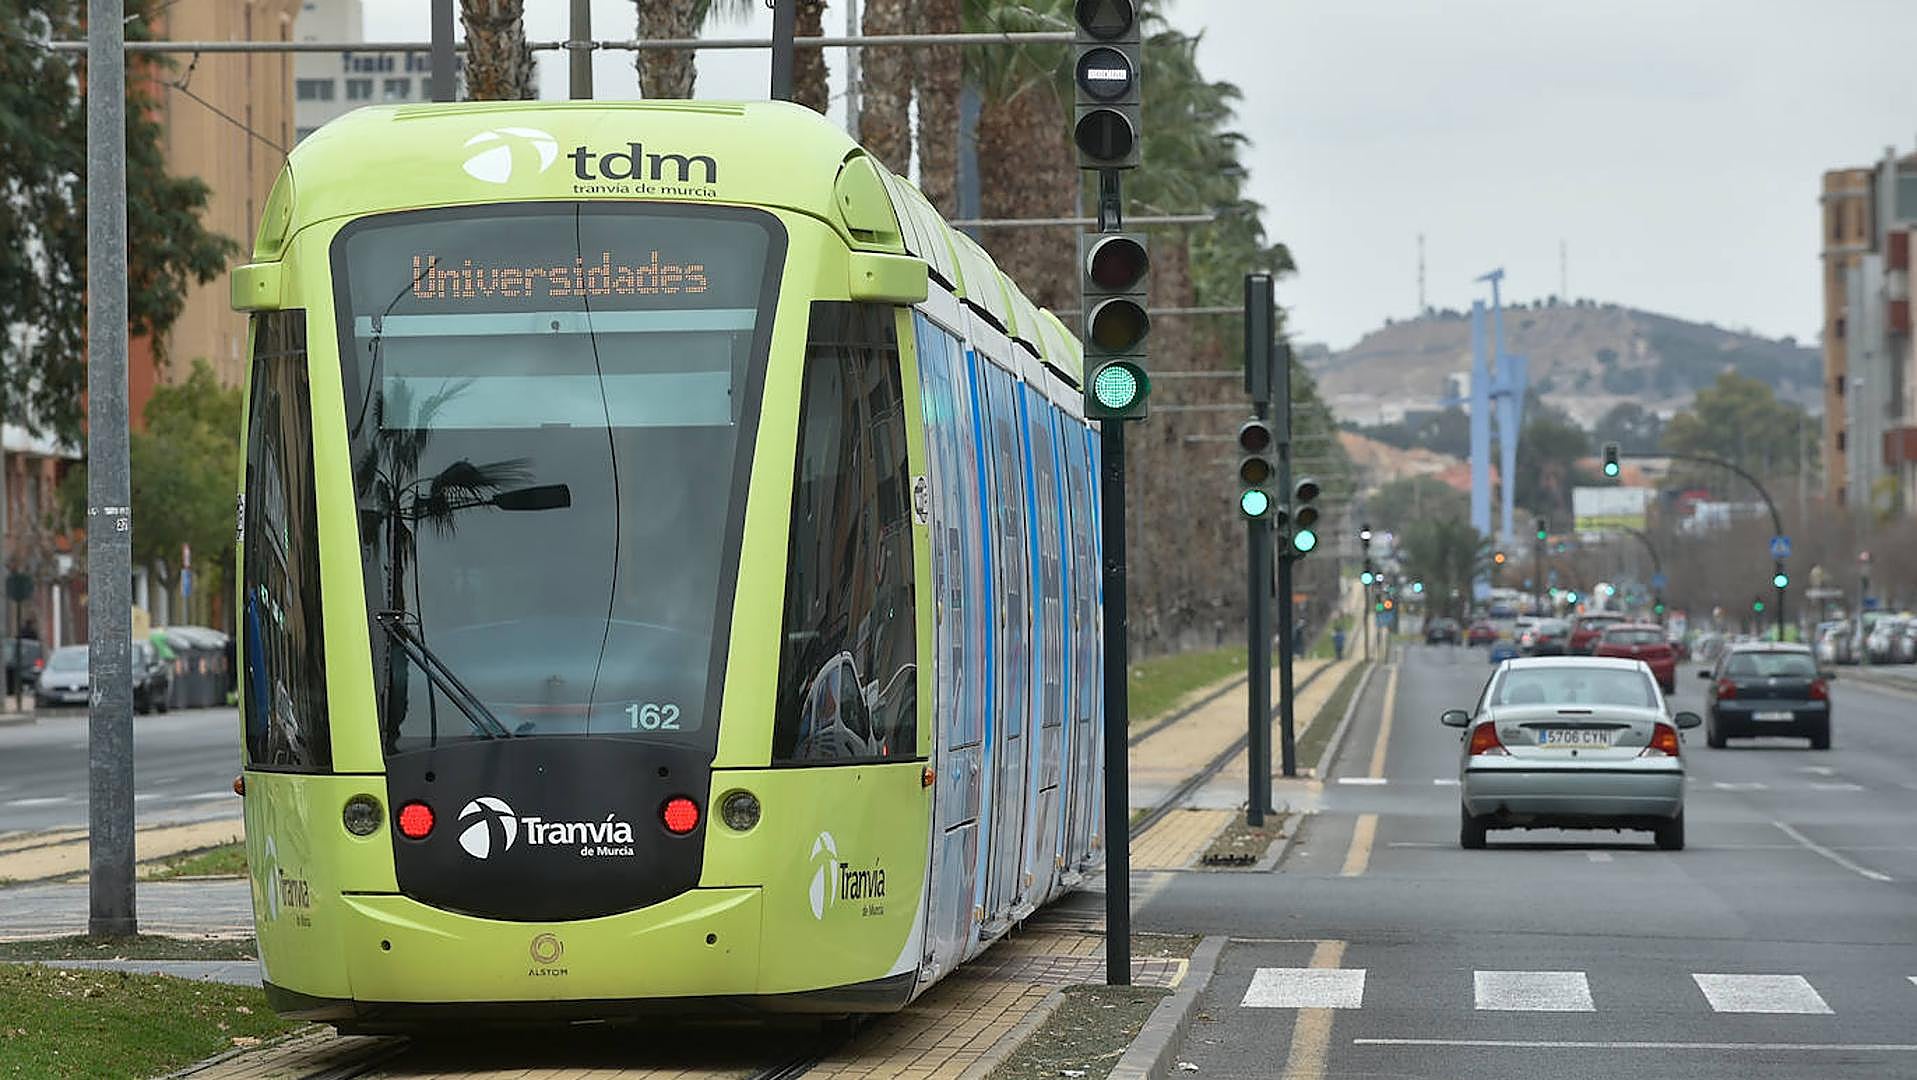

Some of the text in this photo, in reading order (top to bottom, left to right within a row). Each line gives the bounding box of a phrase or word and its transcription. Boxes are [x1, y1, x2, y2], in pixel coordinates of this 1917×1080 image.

[567, 142, 717, 183] tdm
[635, 183, 656, 194] de
[661, 186, 717, 198] murcia
[411, 251, 708, 298] Universidades
[625, 703, 681, 730] 162
[1548, 729, 1608, 744] 5706 CYN
[521, 813, 635, 845] Tranvía
[580, 846, 635, 857] de Murcia
[839, 857, 885, 900] Tranvía
[528, 969, 569, 977] ALSTOM
